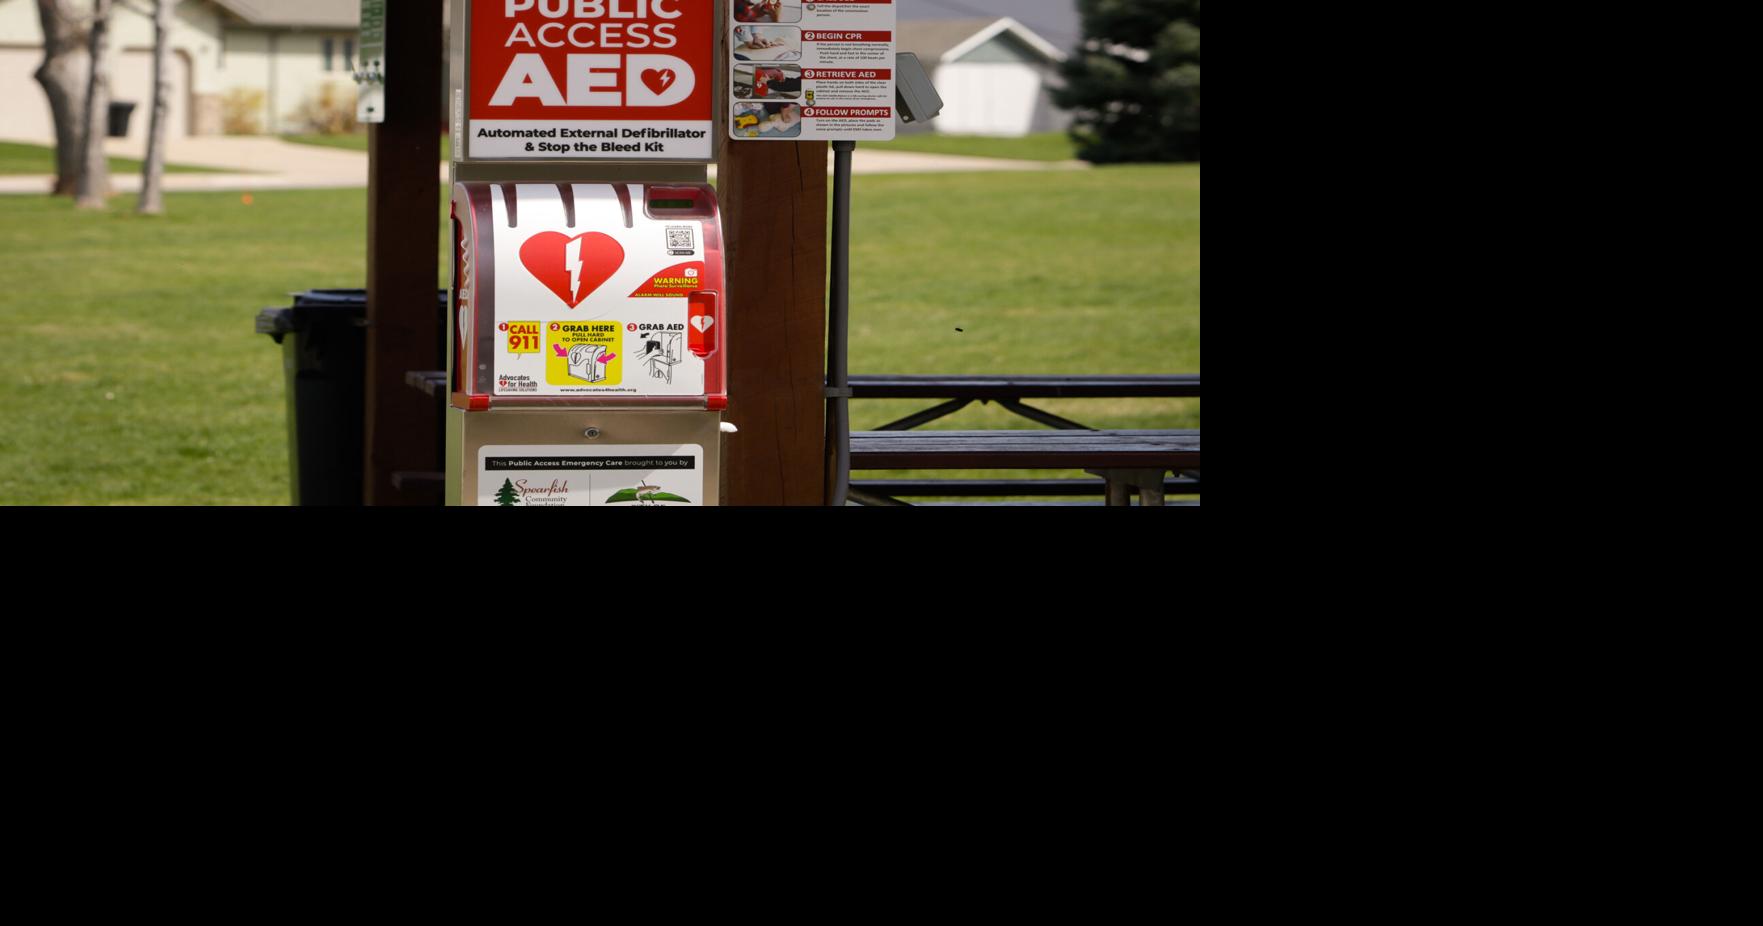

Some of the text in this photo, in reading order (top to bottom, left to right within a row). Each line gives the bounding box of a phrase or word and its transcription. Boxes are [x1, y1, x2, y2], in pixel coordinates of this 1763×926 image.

[504, 0, 682, 19] PUBLIC
[504, 22, 677, 48] ACCESS
[488, 53, 696, 106] AED
[478, 128, 706, 138] Automated External Defibrillator
[525, 142, 664, 154] & Stop the Bleed Kit
[510, 325, 538, 334] CALL
[509, 335, 538, 349] 911
[515, 479, 568, 496] Spearfish
